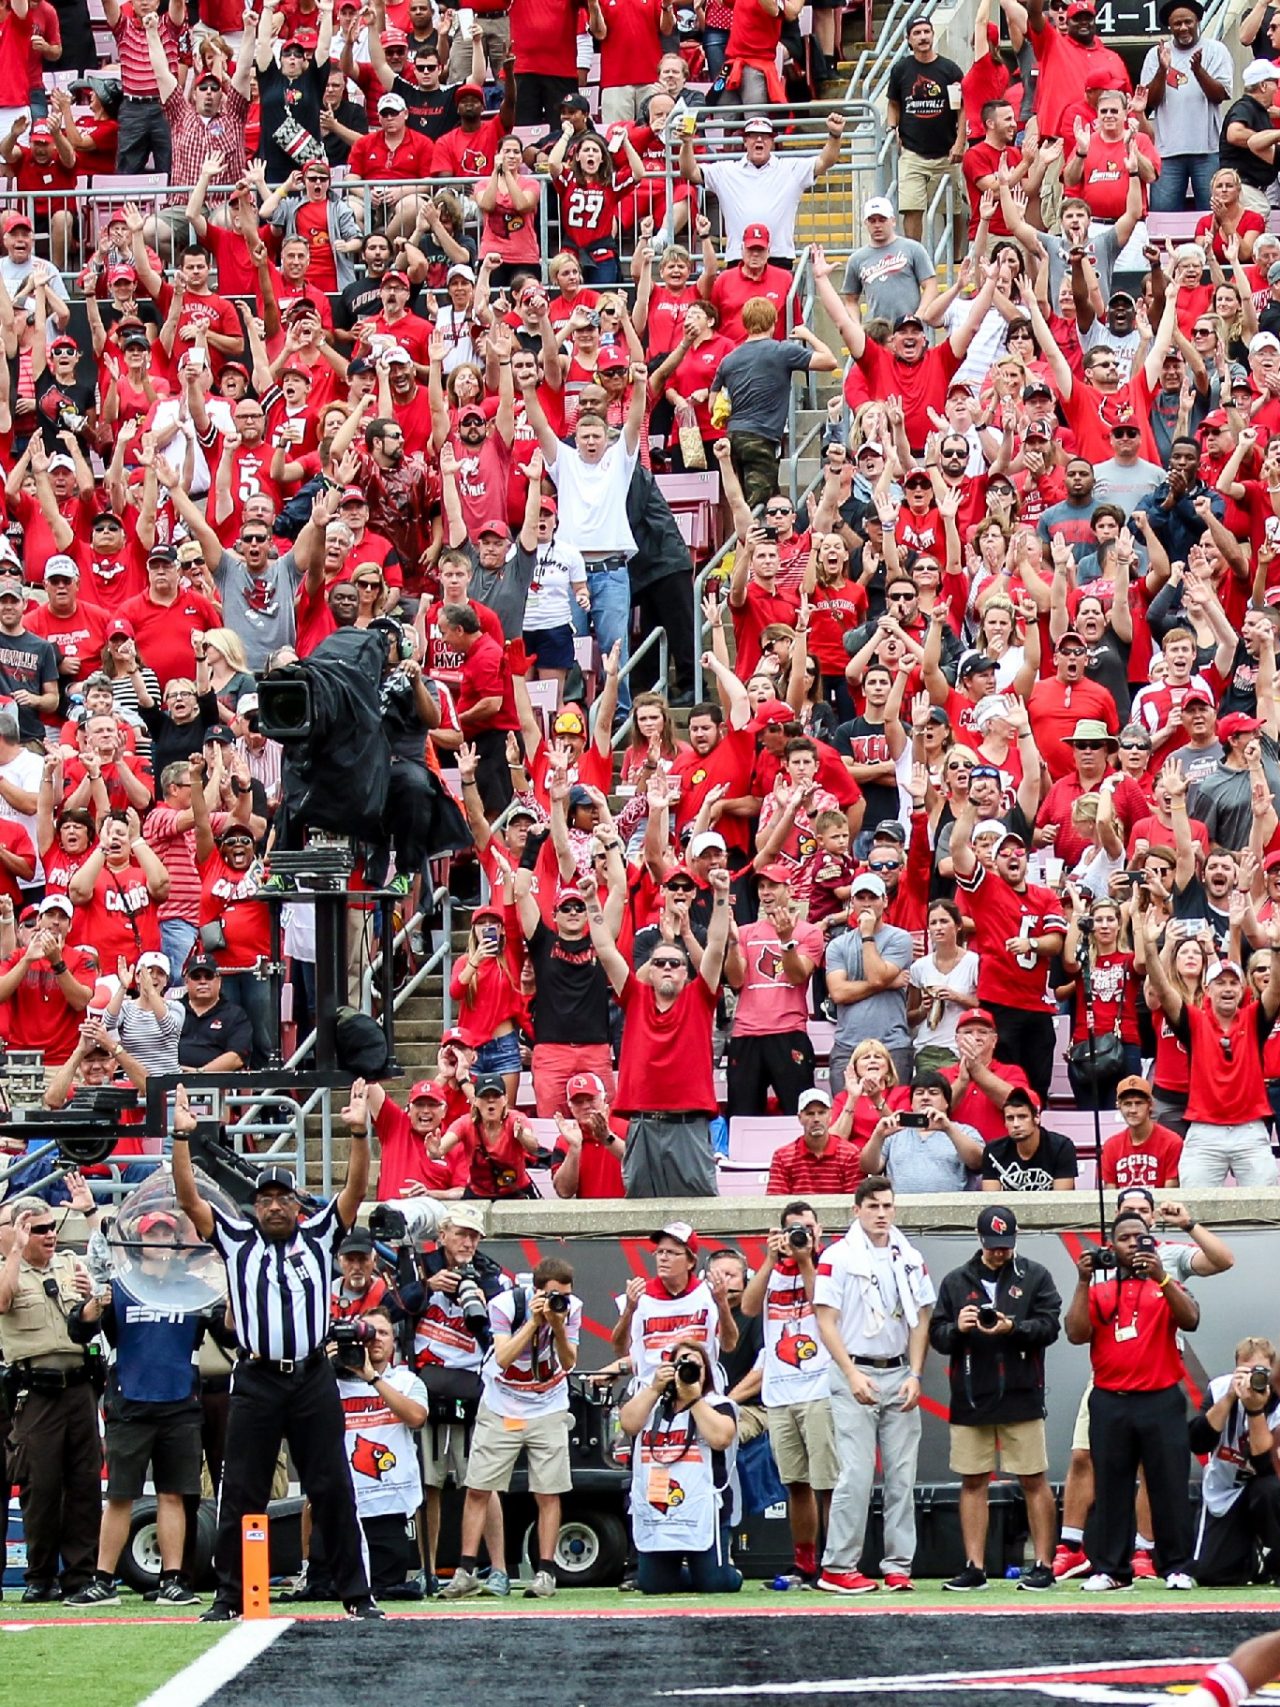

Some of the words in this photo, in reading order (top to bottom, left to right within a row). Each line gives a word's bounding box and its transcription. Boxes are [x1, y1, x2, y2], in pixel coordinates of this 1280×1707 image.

[569, 191, 604, 229] 27
[754, 228, 763, 239] L
[239, 466, 260, 502] 5
[1116, 1153, 1158, 1172] CCHS
[1147, 1170, 1157, 1181] 12
[126, 1304, 184, 1324] ESPN
